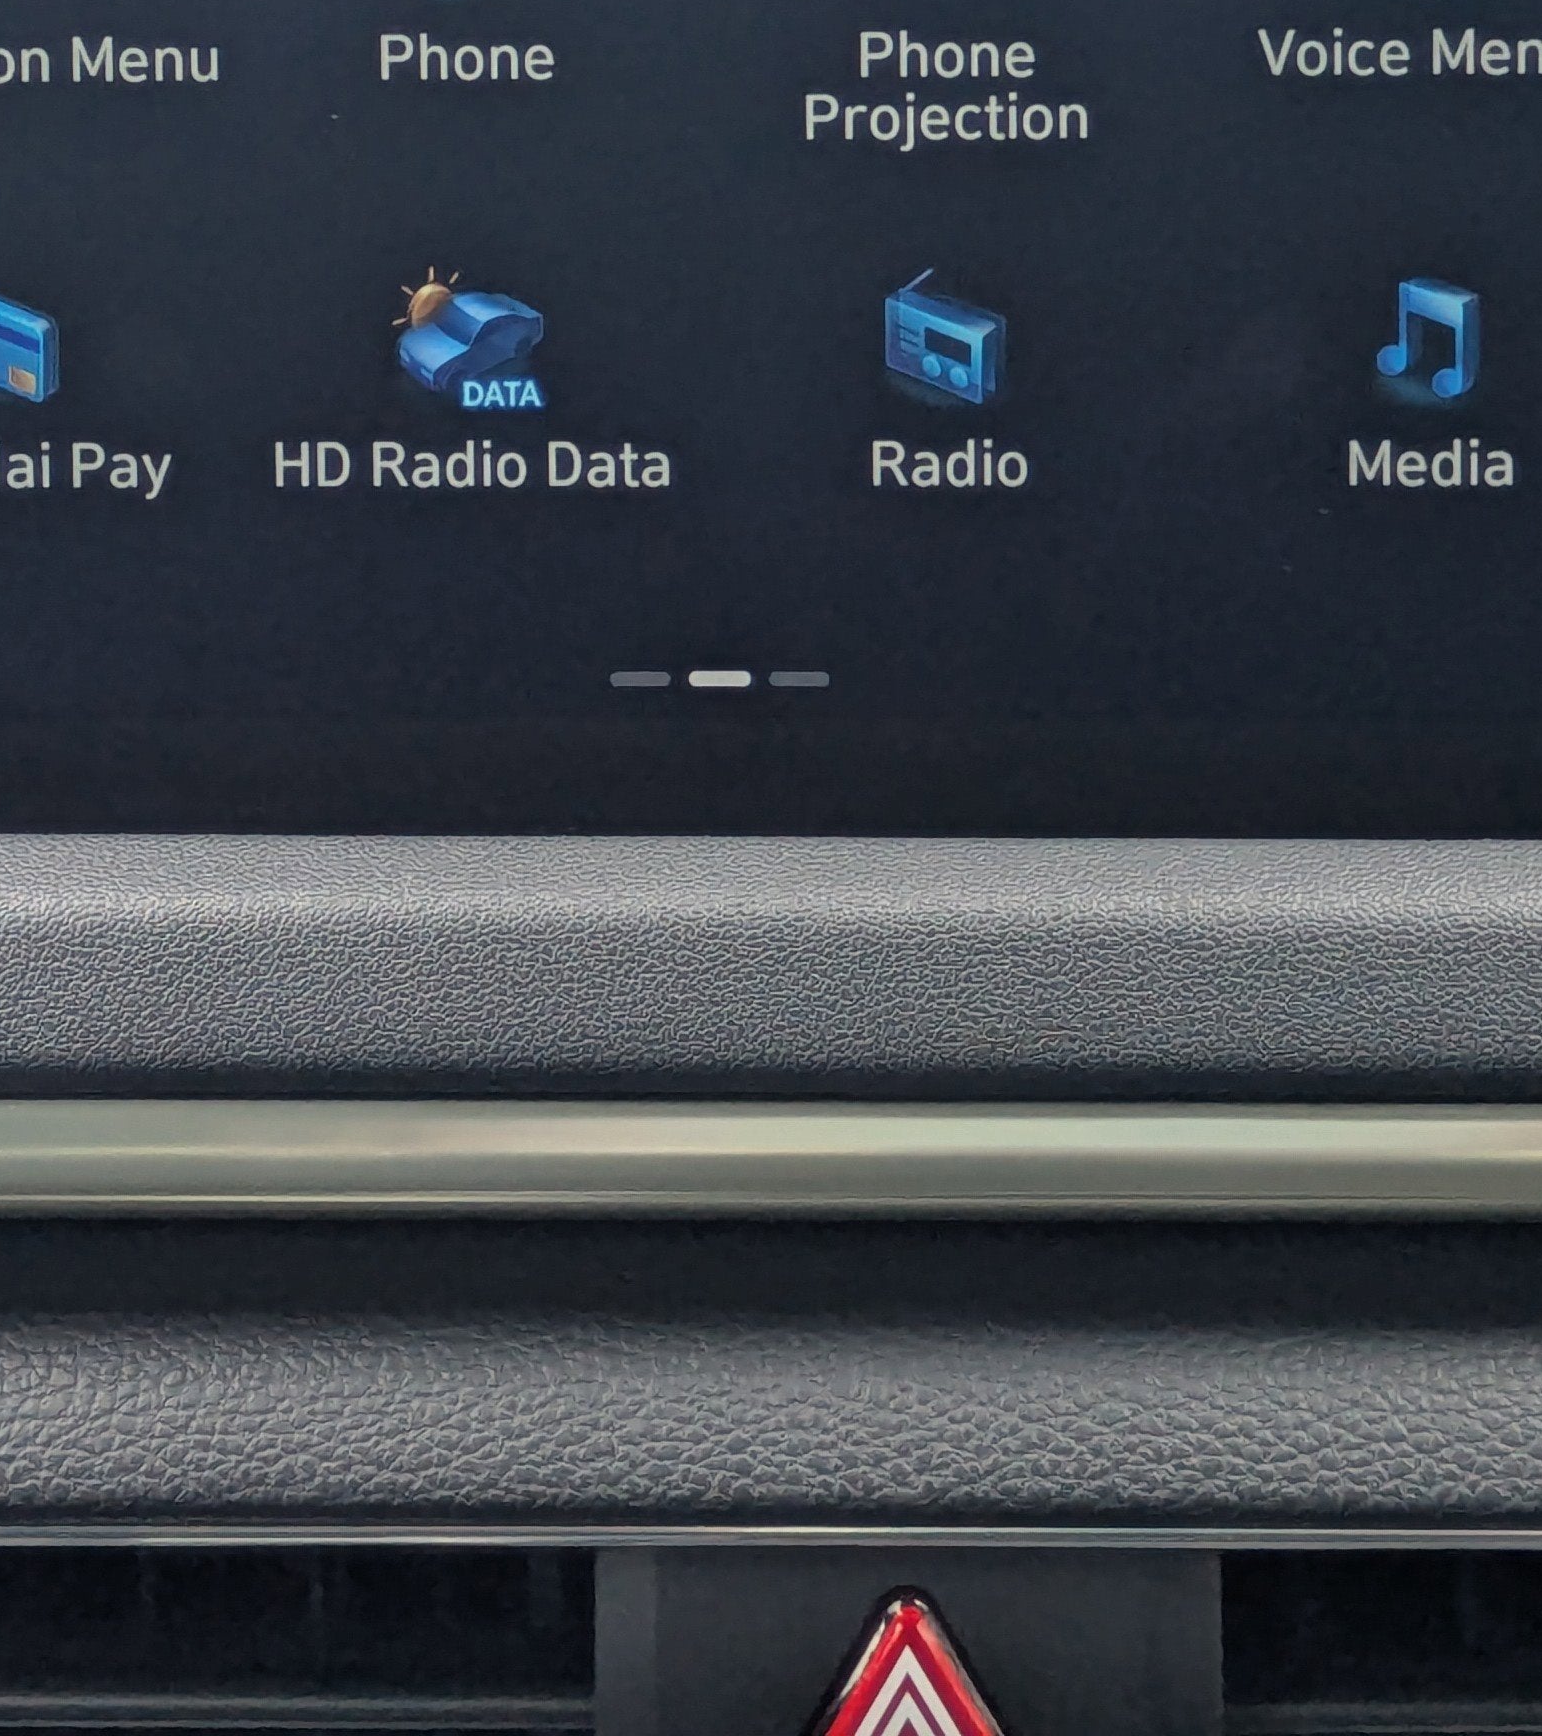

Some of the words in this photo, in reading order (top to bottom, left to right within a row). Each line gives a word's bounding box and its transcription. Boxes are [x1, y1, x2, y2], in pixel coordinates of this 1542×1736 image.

[72, 35, 219, 83] Menu
[380, 32, 555, 81] Phone
[860, 29, 1036, 79] Phone
[1257, 27, 1411, 77] Voice
[805, 91, 1088, 152] Projection
[461, 378, 543, 409] DATA
[72, 442, 172, 500] Pay
[274, 441, 351, 488] HD
[372, 439, 527, 489] Radio
[548, 441, 670, 488] Data
[872, 438, 1028, 488] Radio
[1348, 438, 1514, 488] Media
